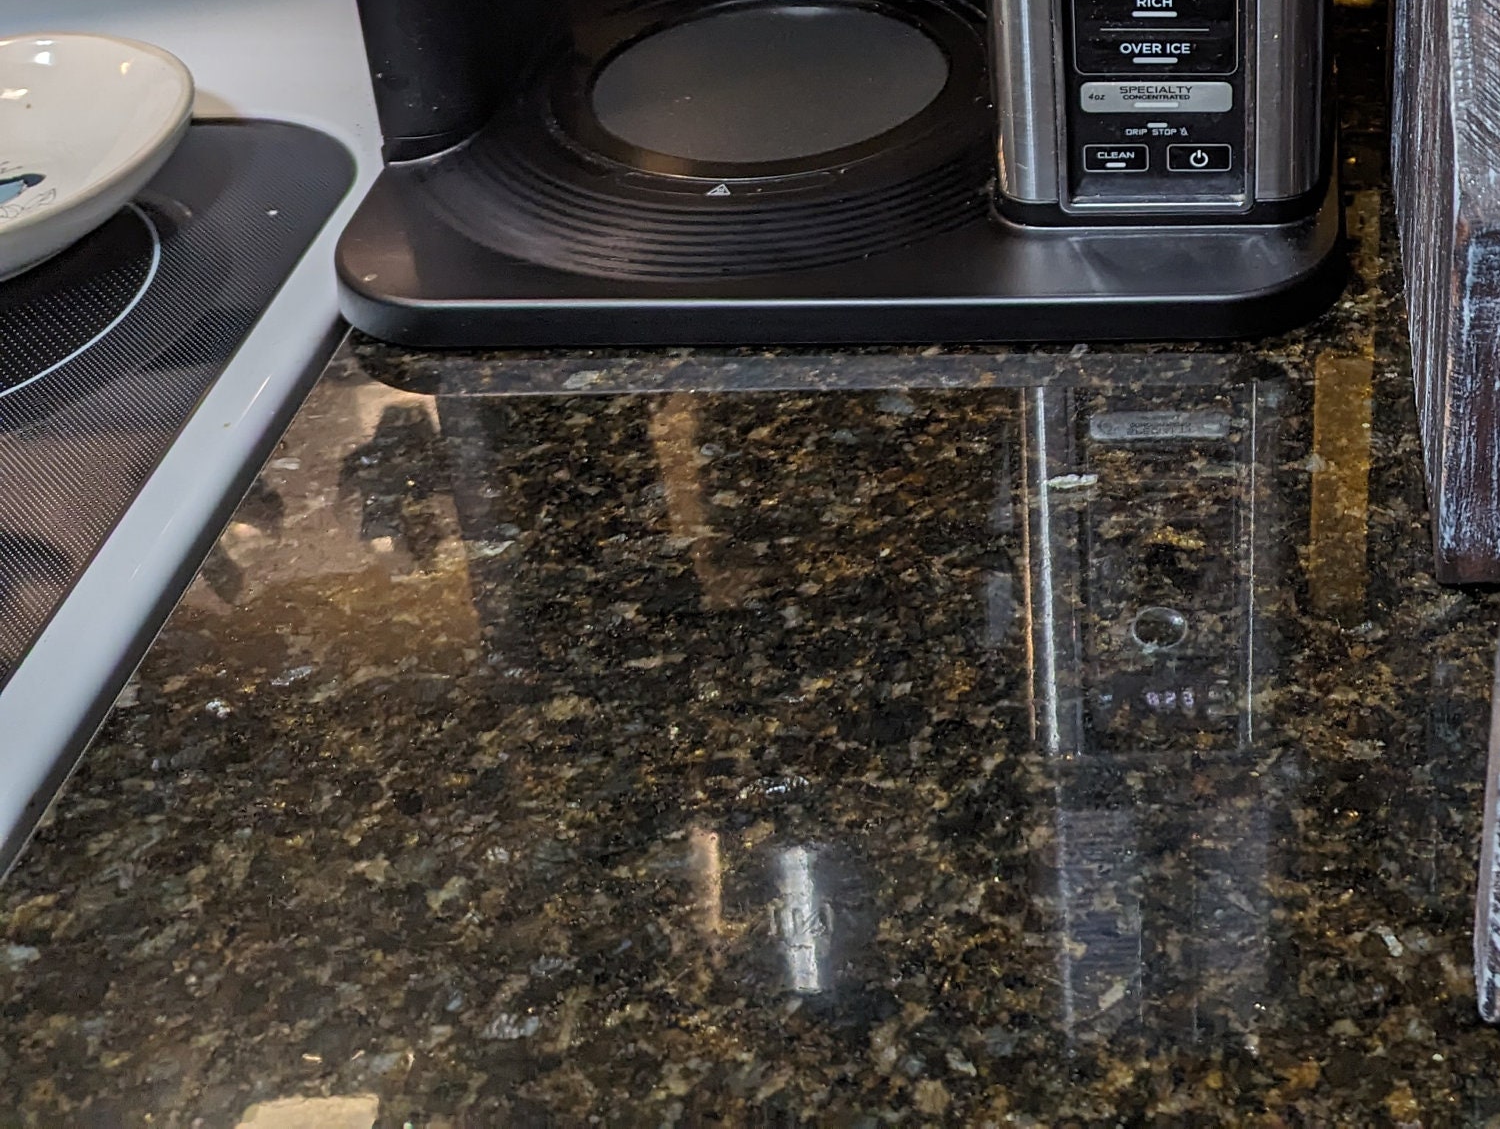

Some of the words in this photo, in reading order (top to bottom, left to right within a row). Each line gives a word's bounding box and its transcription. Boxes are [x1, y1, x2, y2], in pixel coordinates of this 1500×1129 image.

[1119, 43, 1162, 54] OVER
[1166, 43, 1191, 54] ICE
[1119, 86, 1193, 94] SPECIALTY
[1088, 92, 1106, 101] 4oz
[1125, 128, 1148, 136] DRIP
[1152, 128, 1177, 136] STOP
[1097, 151, 1135, 159] CLEAN
